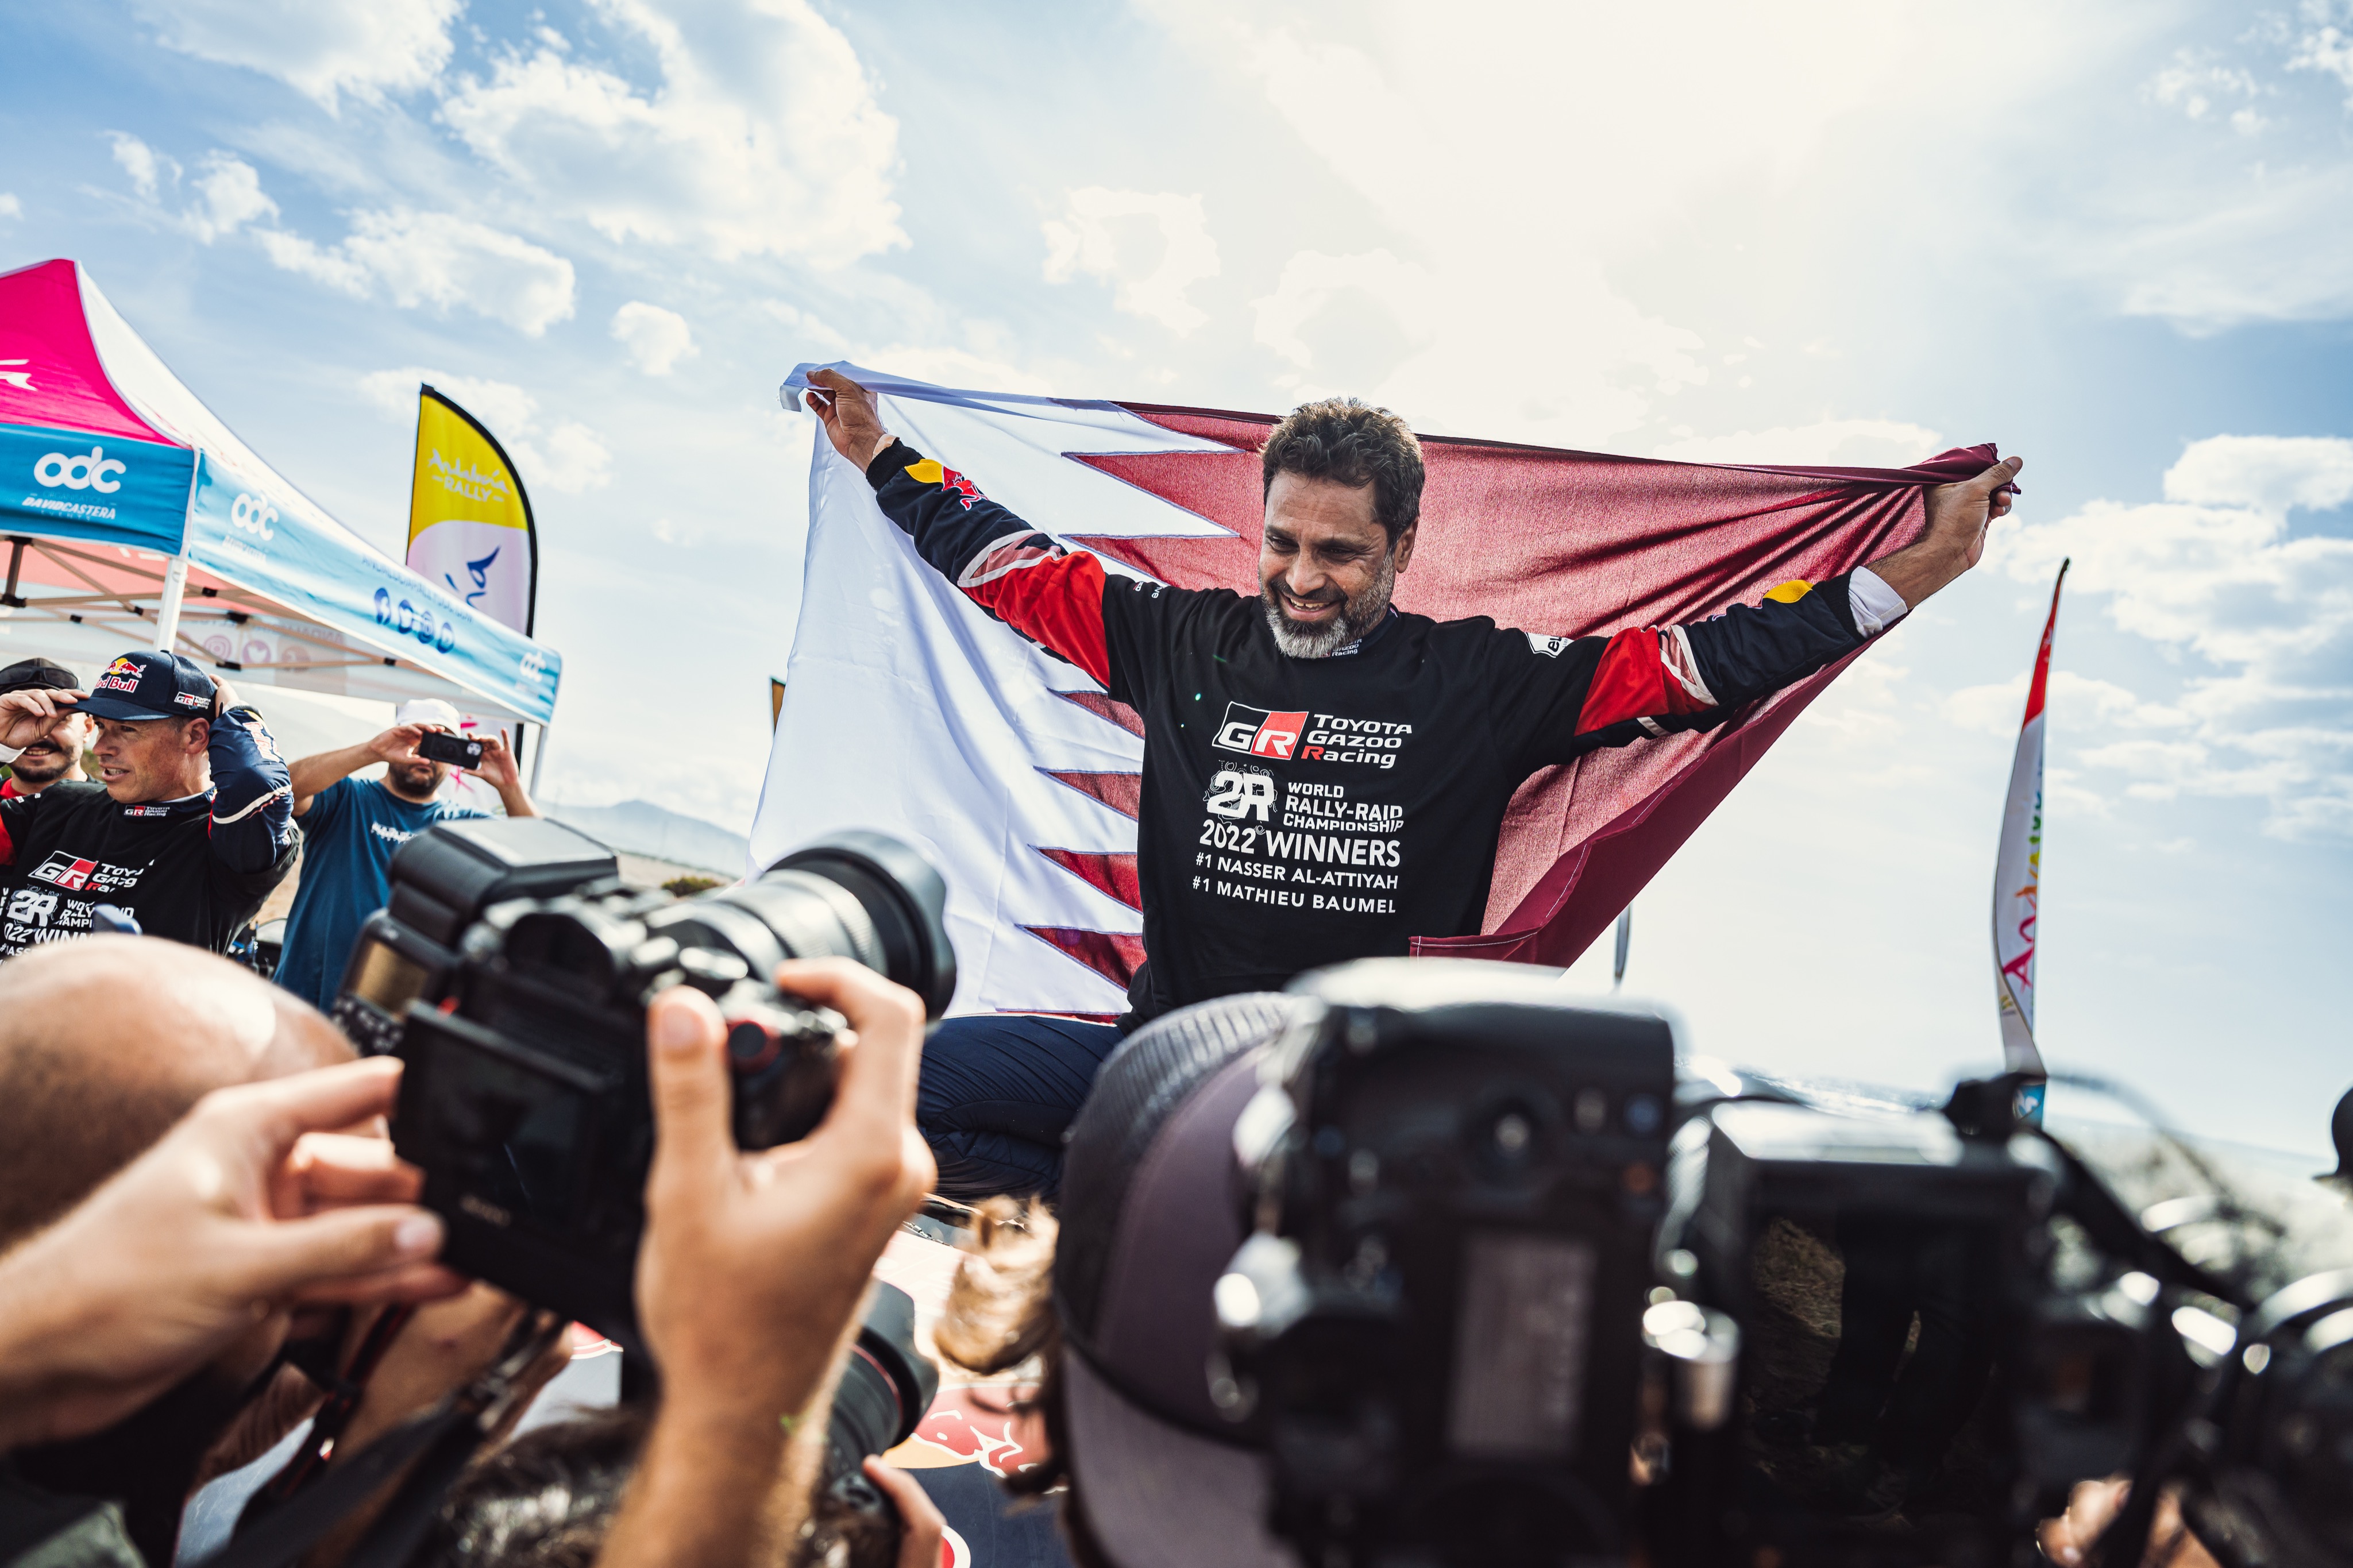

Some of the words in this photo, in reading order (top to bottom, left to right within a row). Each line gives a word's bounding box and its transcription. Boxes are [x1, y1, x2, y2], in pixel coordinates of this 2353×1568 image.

[444, 476, 492, 503] RALLY
[22, 496, 116, 520] DAVIDCASTERA
[1332, 648, 1358, 656] Racing
[108, 676, 139, 693] Bull
[1314, 714, 1412, 734] TOYOTA
[1217, 721, 1298, 760] GR
[1306, 731, 1402, 748] GAZOO
[1301, 745, 1397, 769] Racing
[1287, 782, 1344, 798] WORLD
[125, 808, 144, 816] GR
[1285, 795, 1403, 821] RALLY-RAID
[1283, 813, 1404, 833] CHAMPIONSHIP
[1199, 820, 1256, 854] 2022
[1266, 830, 1401, 867] WINNERS
[34, 862, 89, 889] GR
[1196, 852, 1212, 868] #1
[1217, 857, 1286, 881] NASSER
[1291, 867, 1398, 890] AL-ATTIYAH
[1193, 875, 1209, 892] #1
[1217, 880, 1305, 907] MATHIEU
[1313, 896, 1396, 913] BAUMEL
